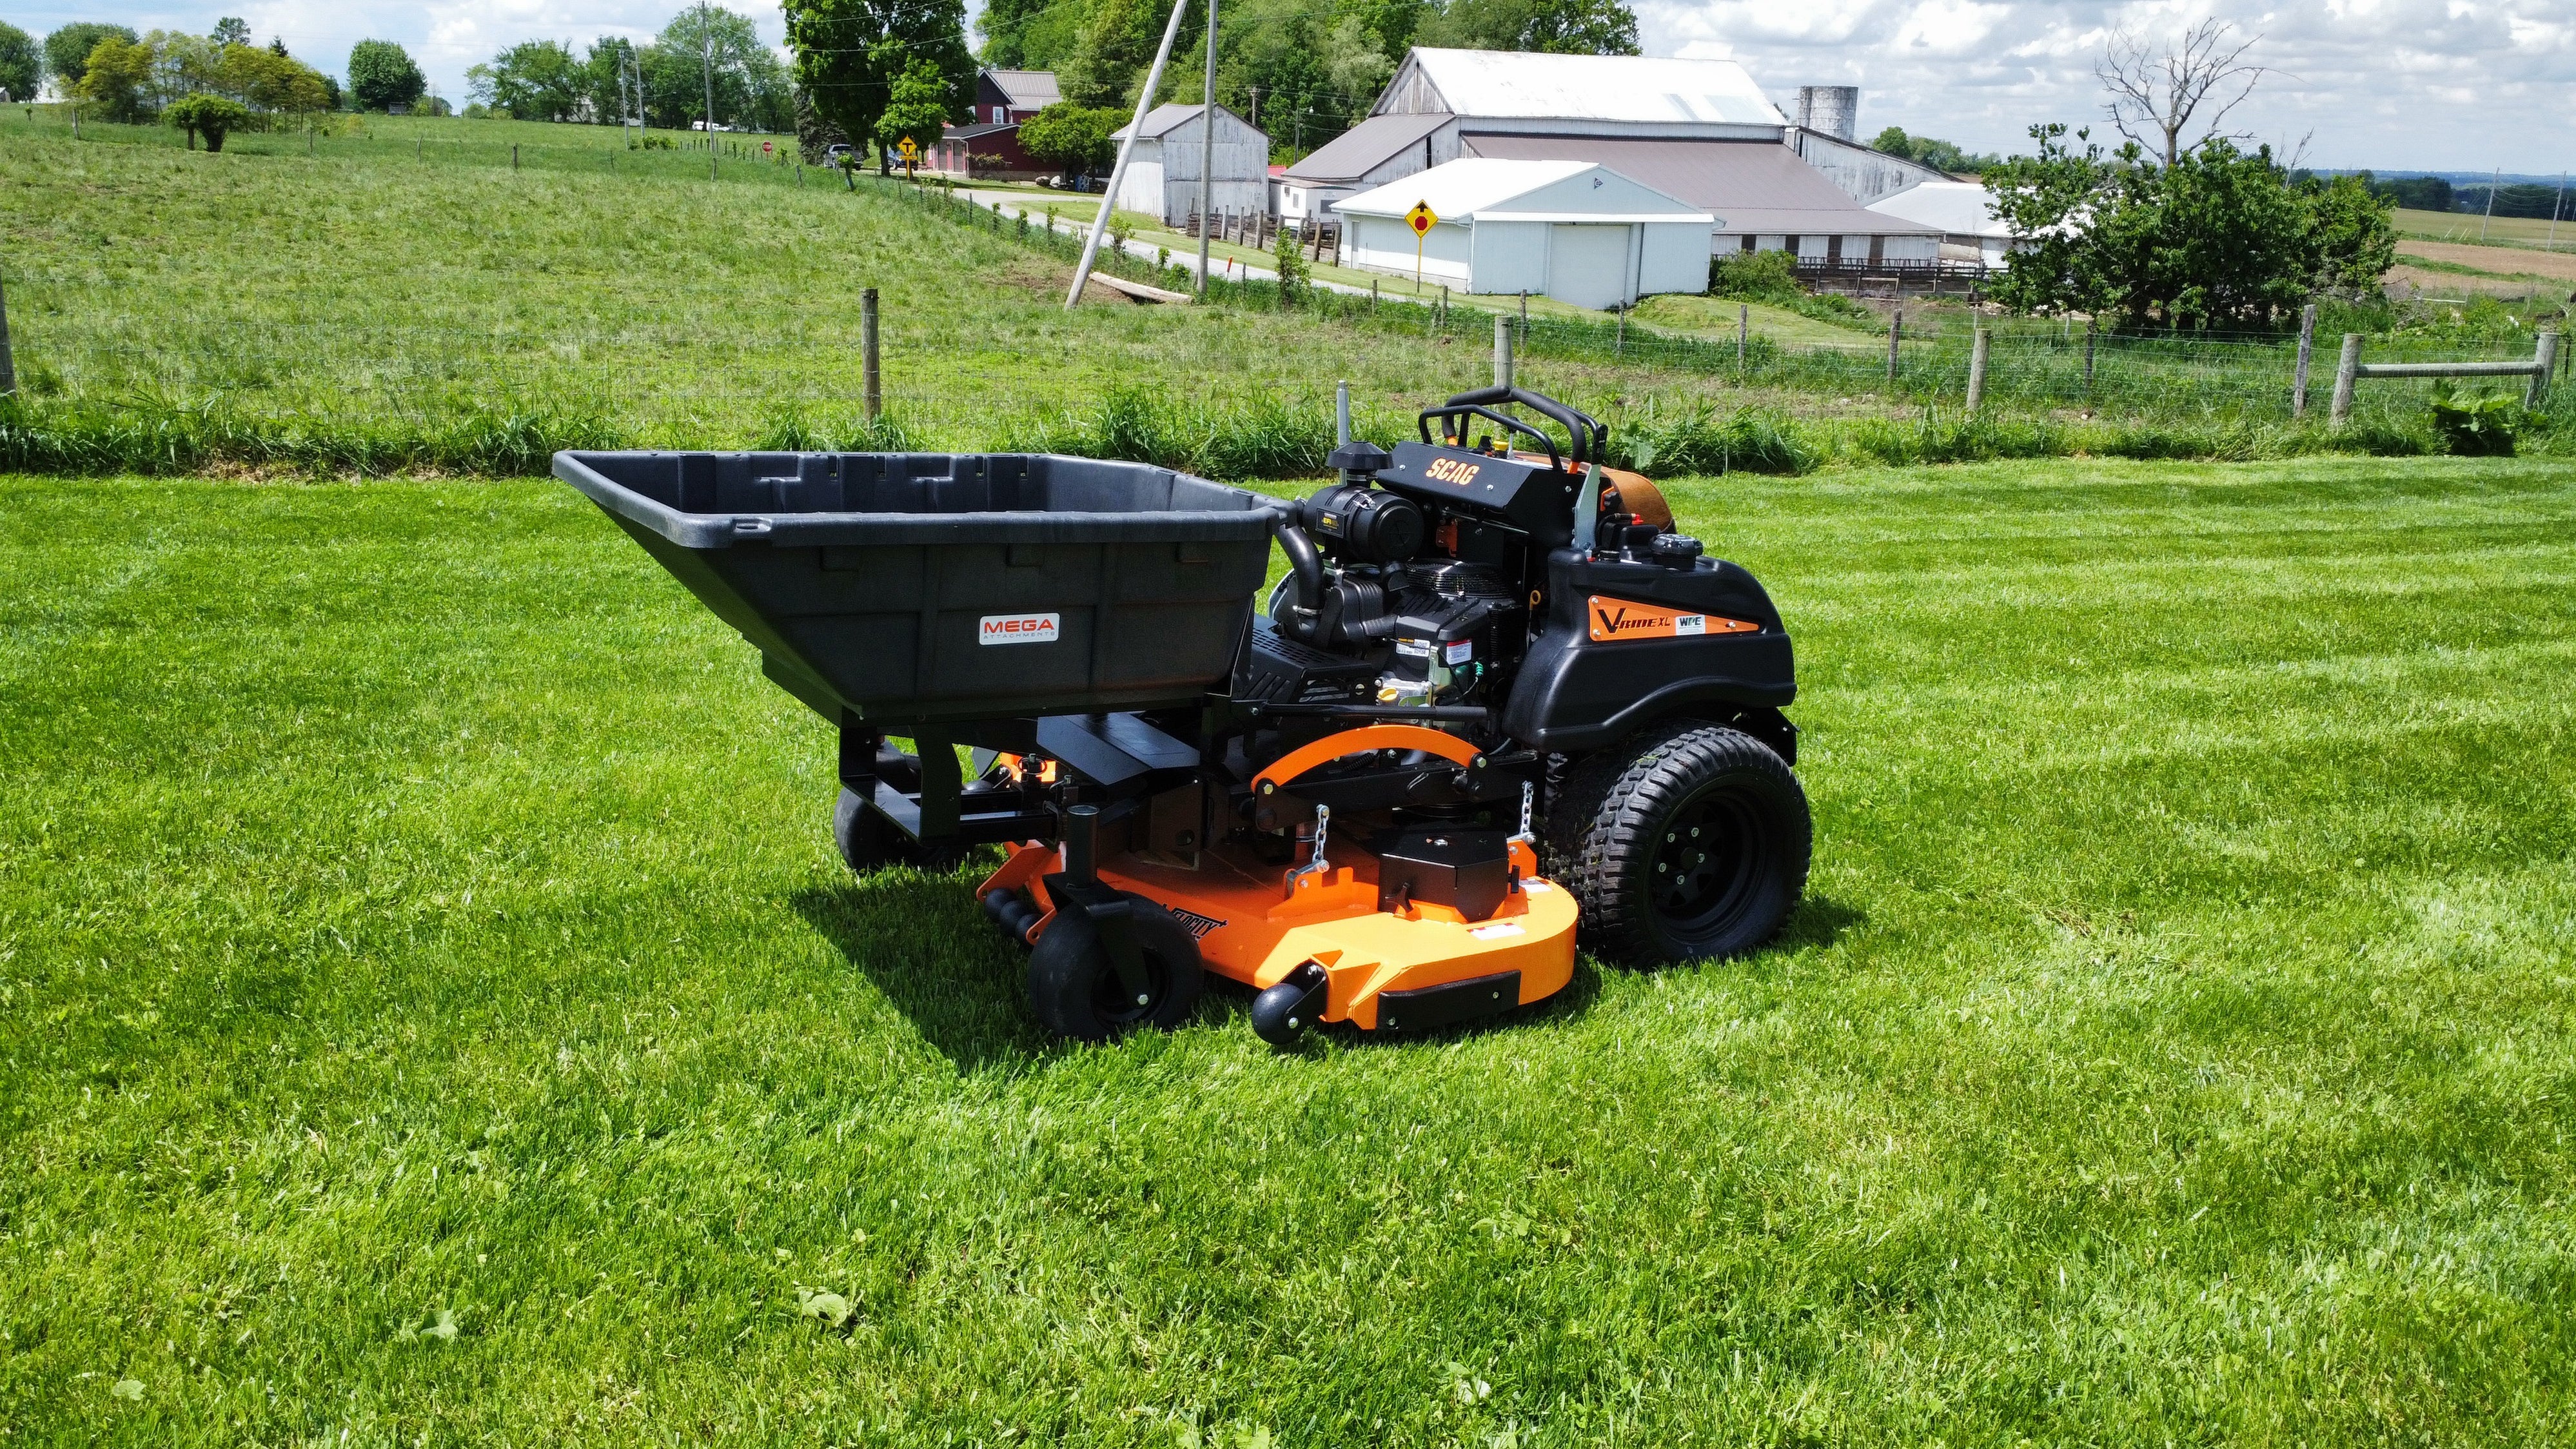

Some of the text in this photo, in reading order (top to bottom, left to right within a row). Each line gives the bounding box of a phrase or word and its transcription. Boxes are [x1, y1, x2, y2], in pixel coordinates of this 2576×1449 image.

[1425, 457, 1480, 485] SCAG
[984, 619, 1054, 633] MEGA
[1658, 616, 1671, 627] XL
